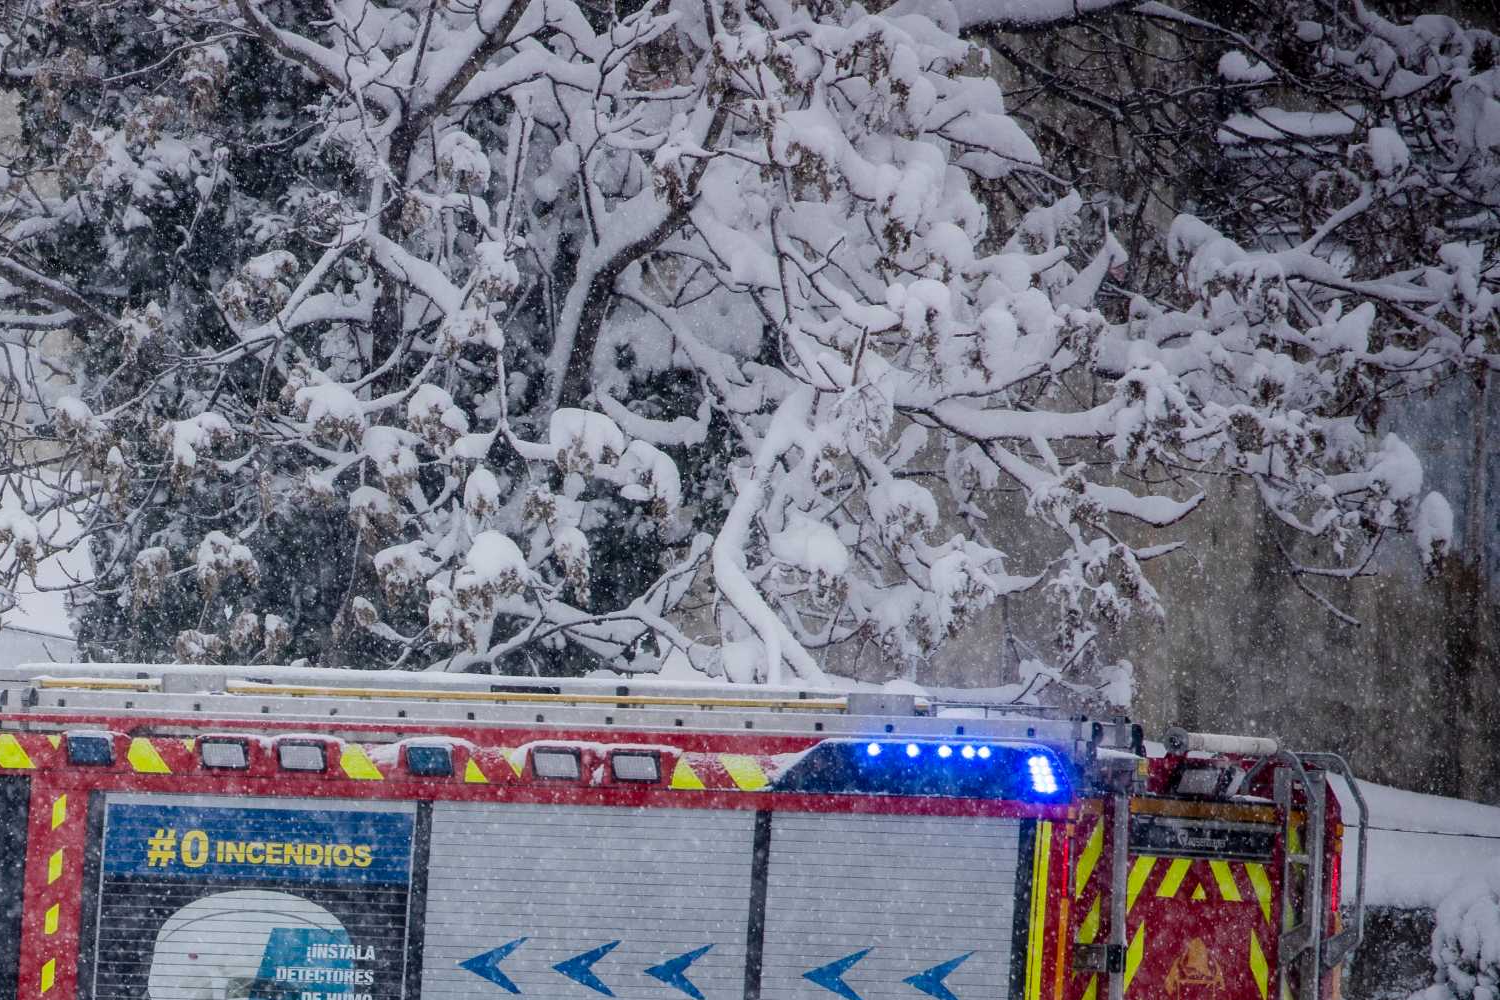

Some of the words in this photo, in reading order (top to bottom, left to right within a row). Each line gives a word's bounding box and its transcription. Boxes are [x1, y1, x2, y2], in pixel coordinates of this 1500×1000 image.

[148, 828, 209, 868] #0
[216, 840, 373, 868] INCENDIOS
[276, 966, 375, 986] DETECTORES
